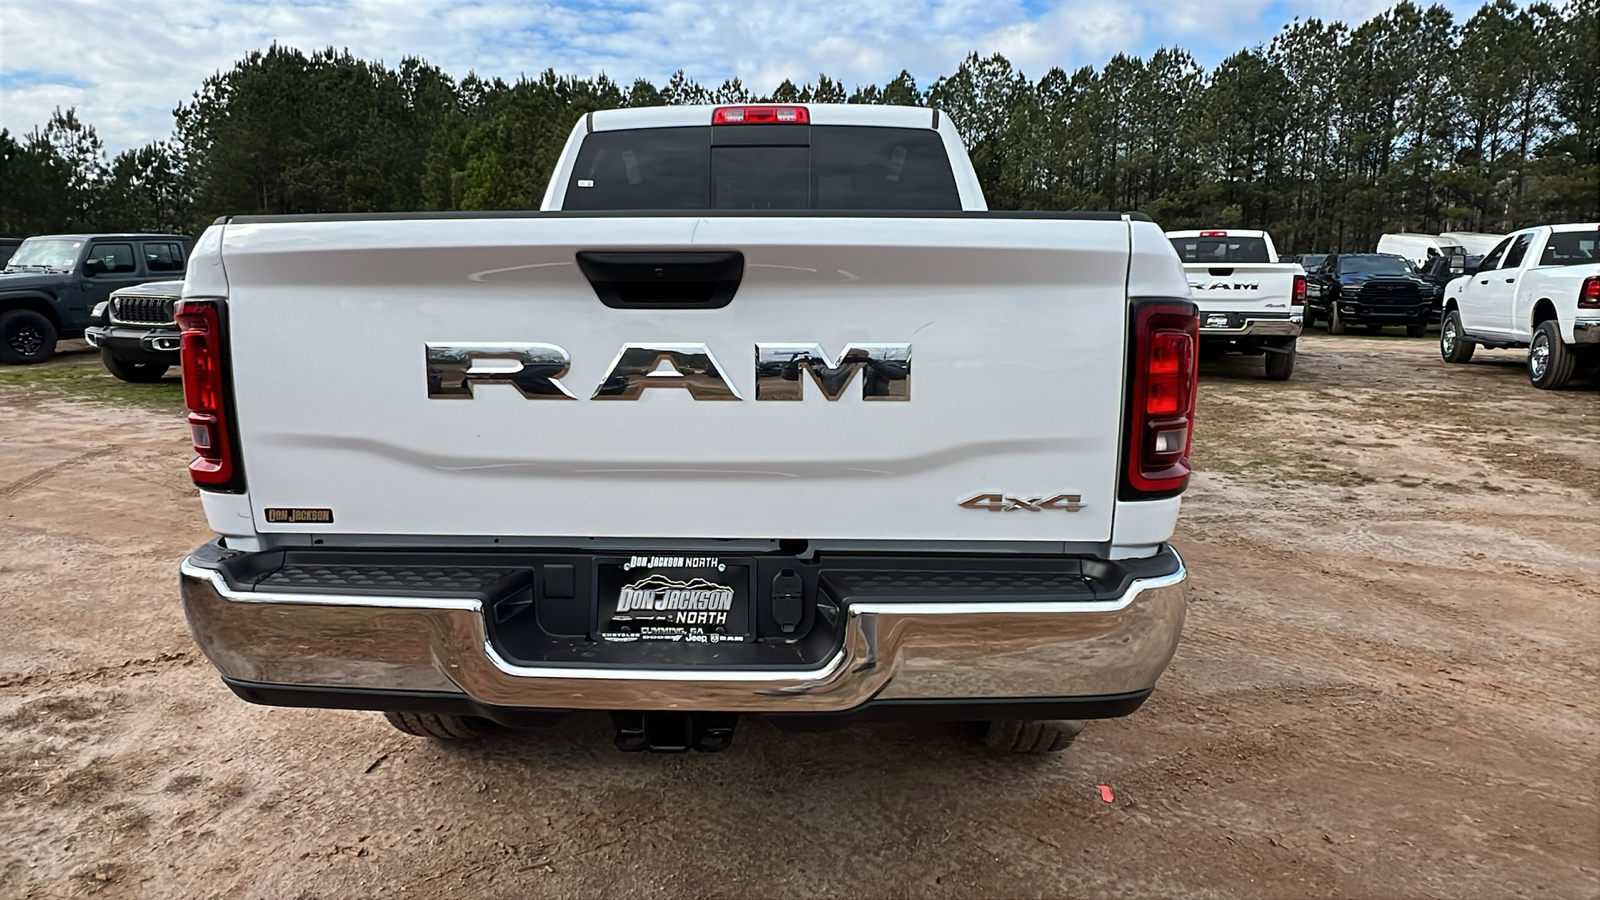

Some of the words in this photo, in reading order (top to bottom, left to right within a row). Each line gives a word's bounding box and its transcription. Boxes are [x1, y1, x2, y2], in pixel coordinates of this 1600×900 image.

[424, 341, 912, 401] RAM
[958, 493, 1087, 512] 4x4
[268, 509, 288, 522] DON
[288, 509, 329, 522] JACKSON
[630, 556, 648, 568] DON
[648, 556, 684, 568] JACKSON
[685, 558, 718, 568] NORTH
[616, 588, 656, 612] DON
[654, 589, 734, 611] JACKSON
[676, 612, 727, 624] NORTH
[686, 634, 708, 643] Jeep
